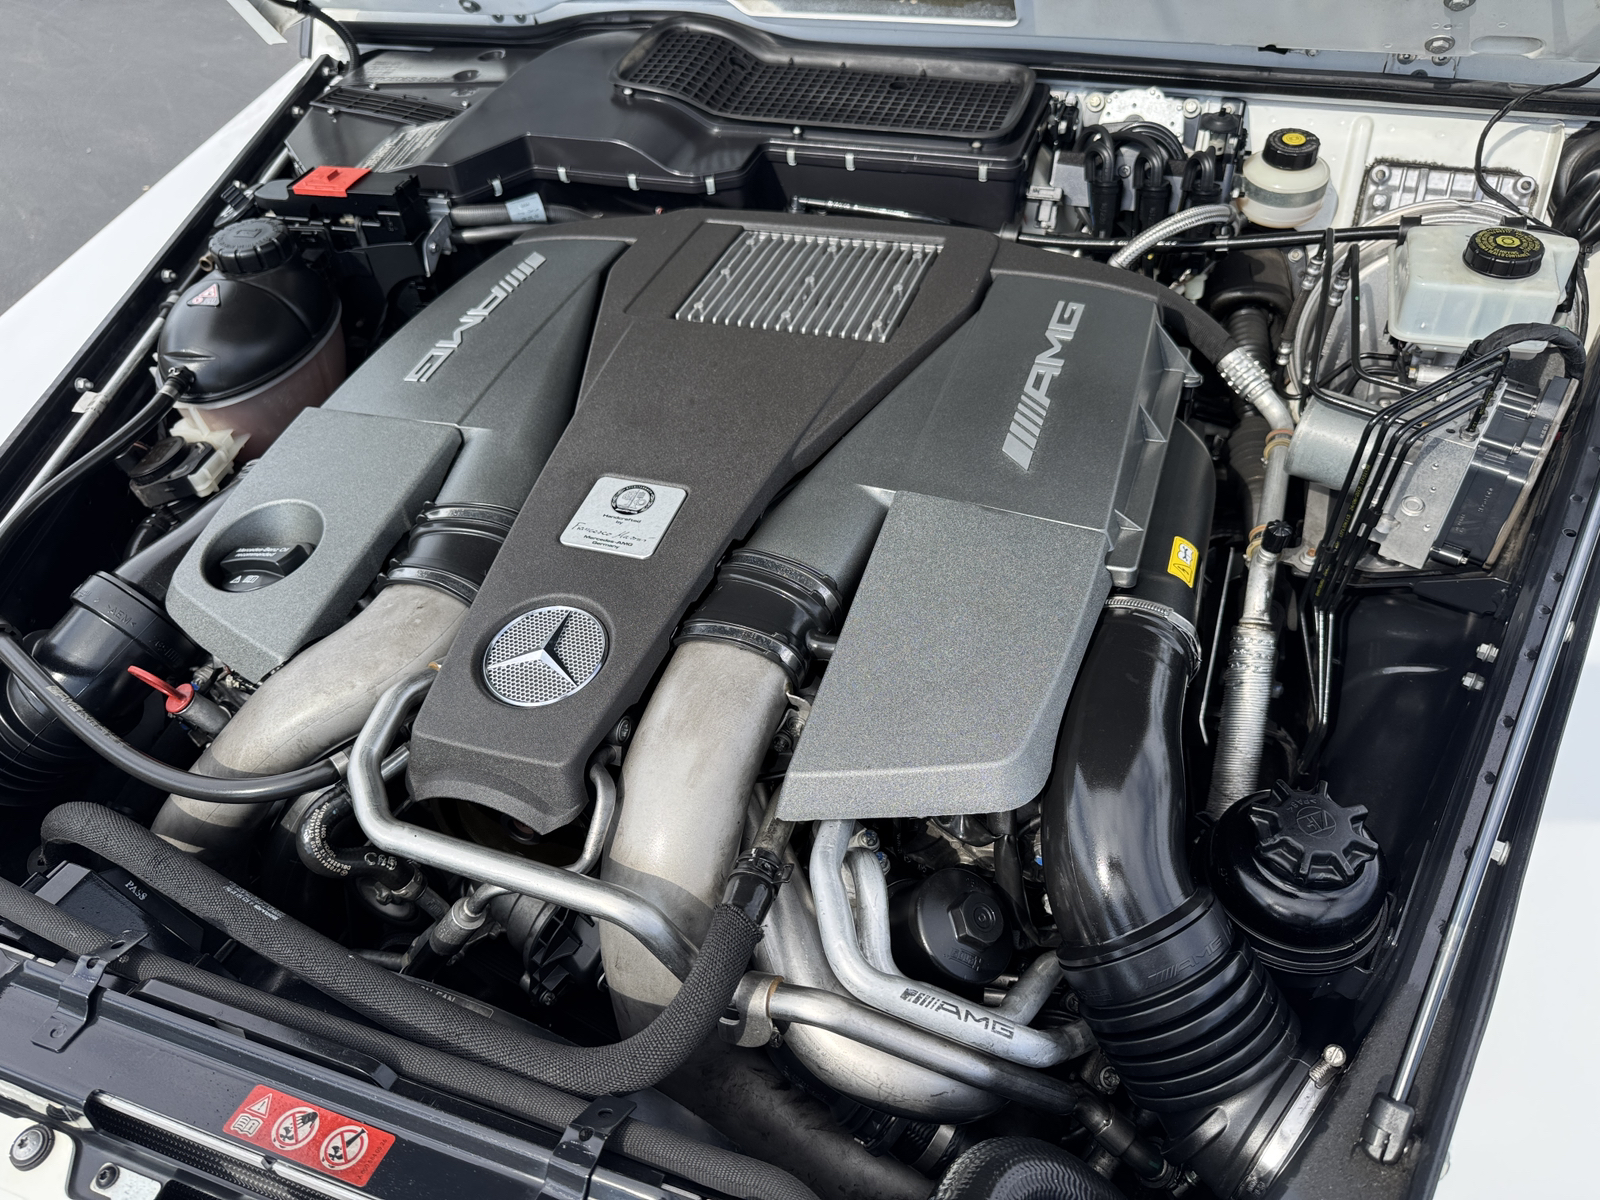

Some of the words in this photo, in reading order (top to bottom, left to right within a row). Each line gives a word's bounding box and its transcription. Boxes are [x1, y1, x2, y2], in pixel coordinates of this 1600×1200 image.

[404, 285, 509, 382] AMG
[1024, 300, 1086, 410] AMG
[602, 513, 642, 524] Handcrafted
[583, 534, 634, 547] Mercedes-AMG
[591, 540, 621, 550] Germany
[125, 880, 148, 901] PASS
[935, 1000, 1015, 1040] AMG
